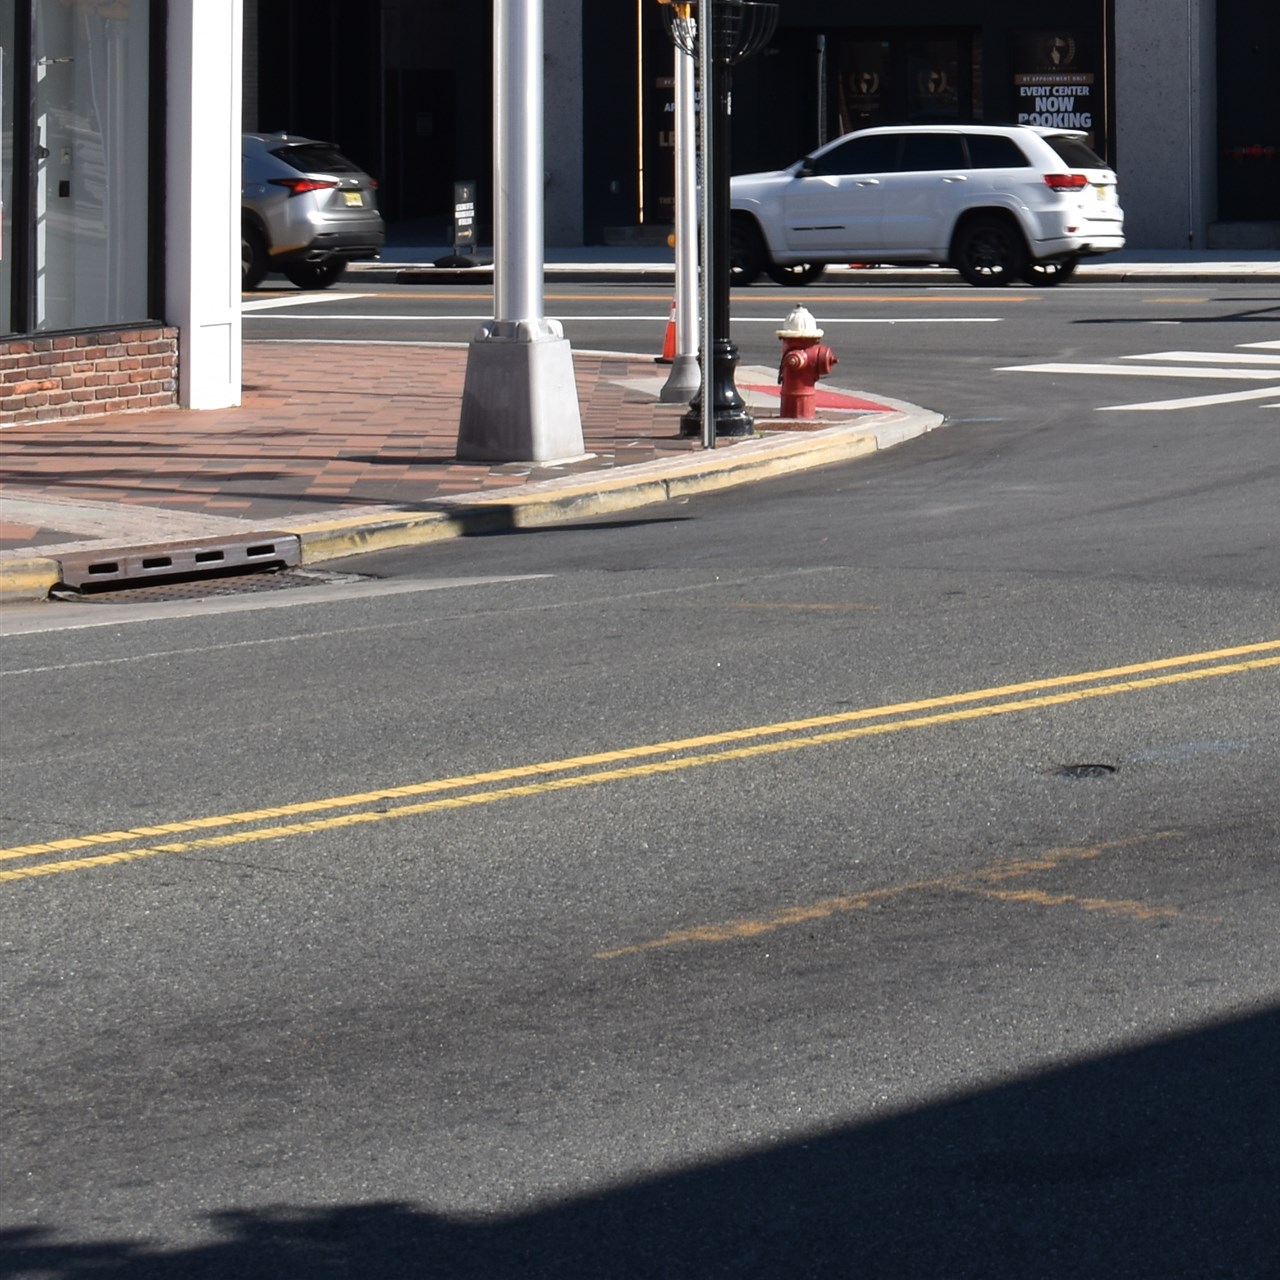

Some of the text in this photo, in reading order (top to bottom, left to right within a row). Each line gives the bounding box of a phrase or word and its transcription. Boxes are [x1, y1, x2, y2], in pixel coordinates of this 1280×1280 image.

[1020, 86, 1089, 97] EVENT CENTER
[1035, 96, 1075, 112] NOW
